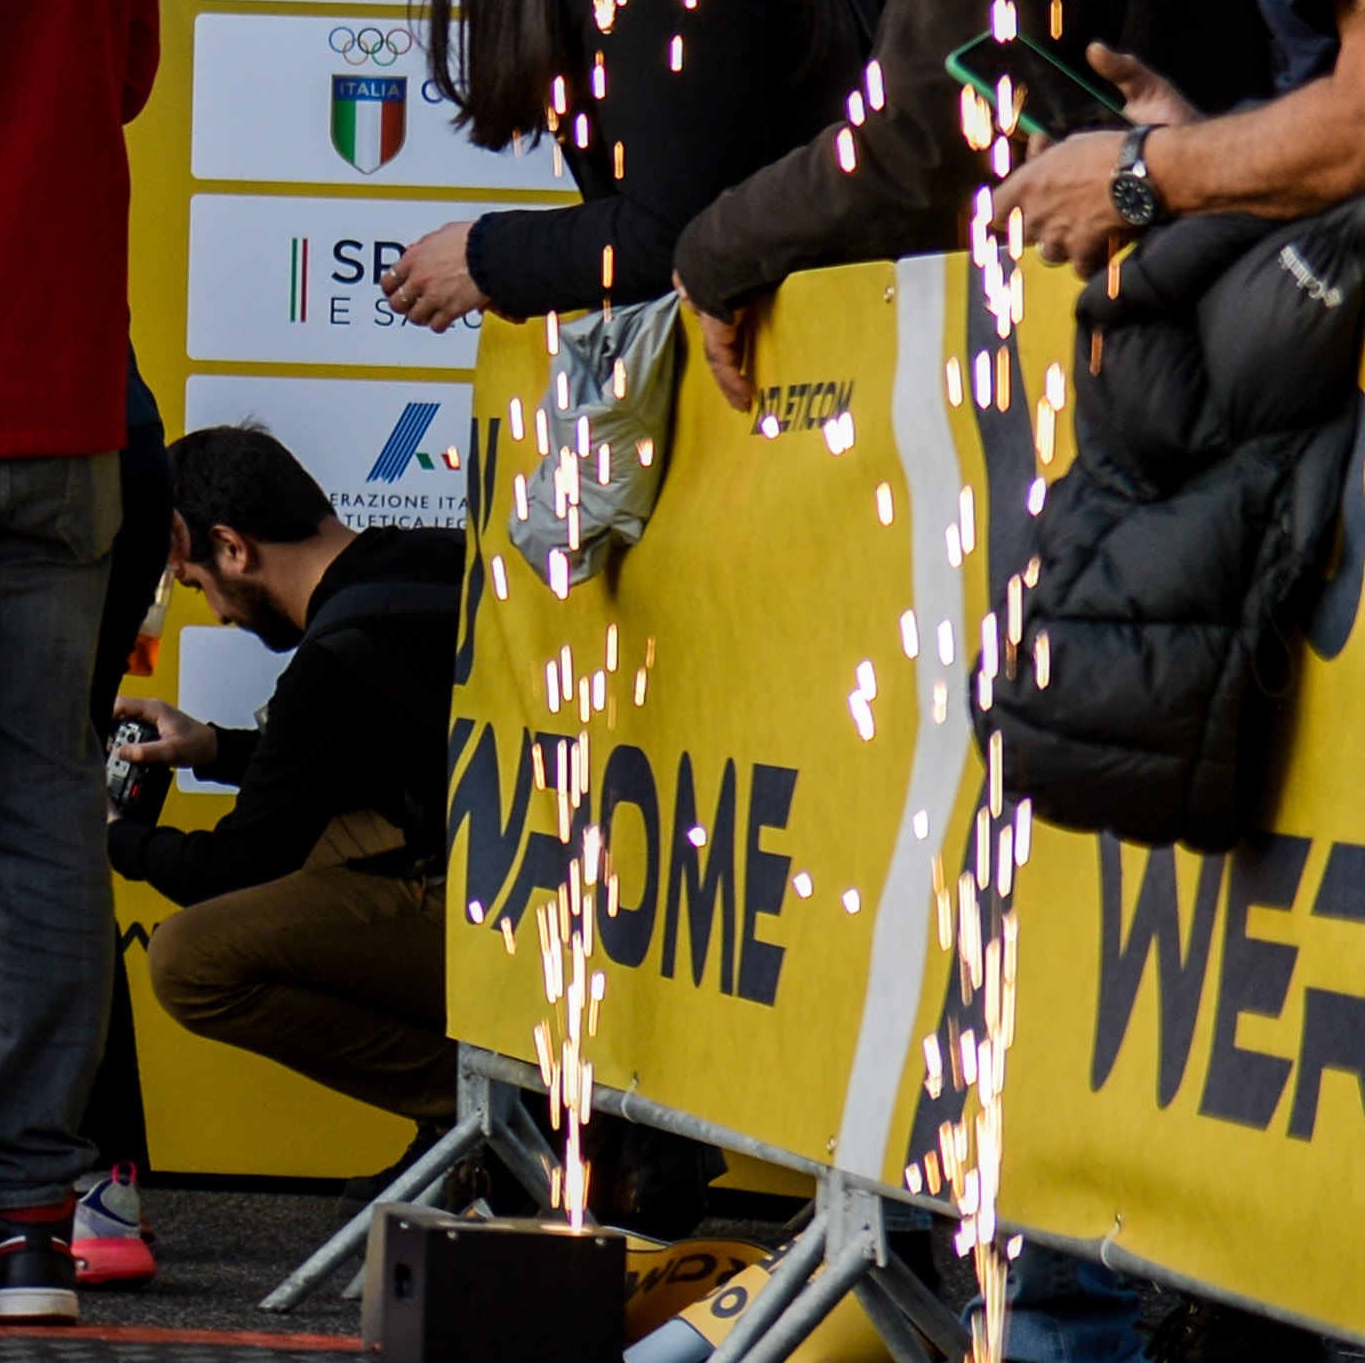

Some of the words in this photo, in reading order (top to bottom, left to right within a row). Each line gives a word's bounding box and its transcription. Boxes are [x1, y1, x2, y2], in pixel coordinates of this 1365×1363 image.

[339, 81, 400, 97] ITALIA
[330, 493, 429, 510] ERAZIONE
[439, 497, 468, 510] ITA
[344, 514, 425, 530] TLETICA
